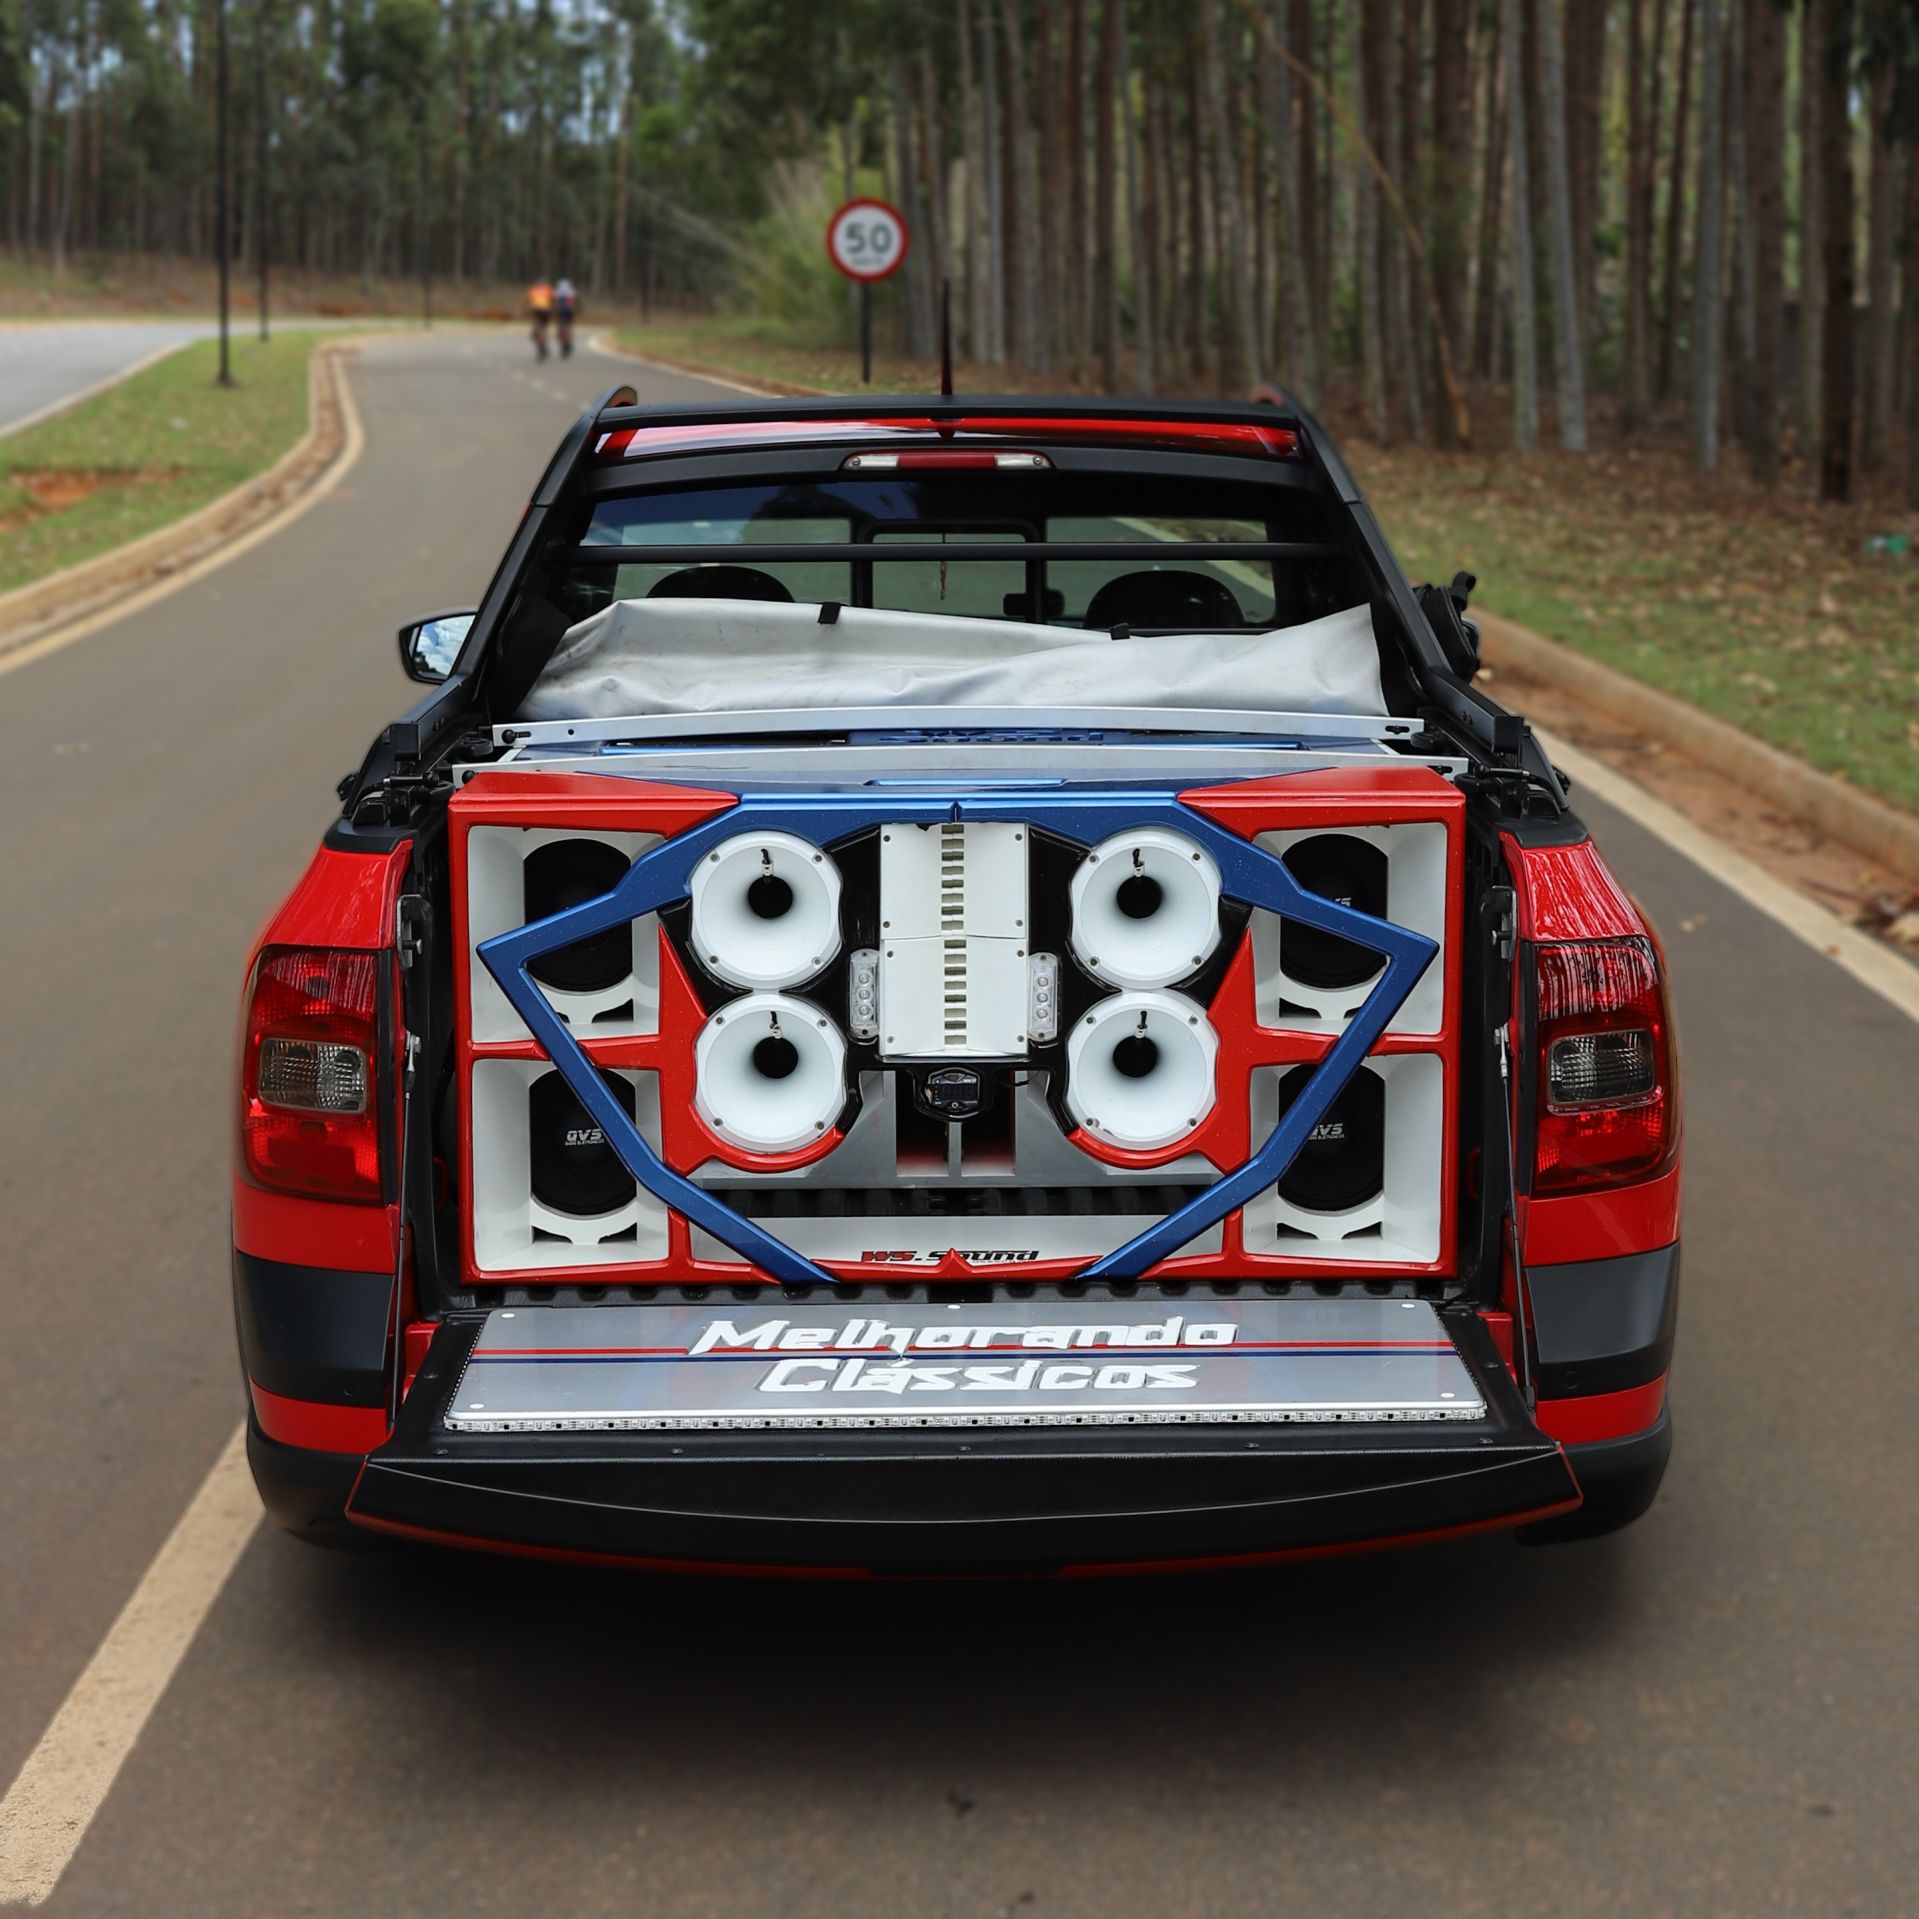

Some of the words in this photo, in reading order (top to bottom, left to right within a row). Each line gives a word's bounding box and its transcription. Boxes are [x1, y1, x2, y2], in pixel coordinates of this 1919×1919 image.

[846, 222, 892, 255] 50
[688, 1316, 1239, 1357] Melhorando
[758, 1358, 1200, 1394] Clássicos
